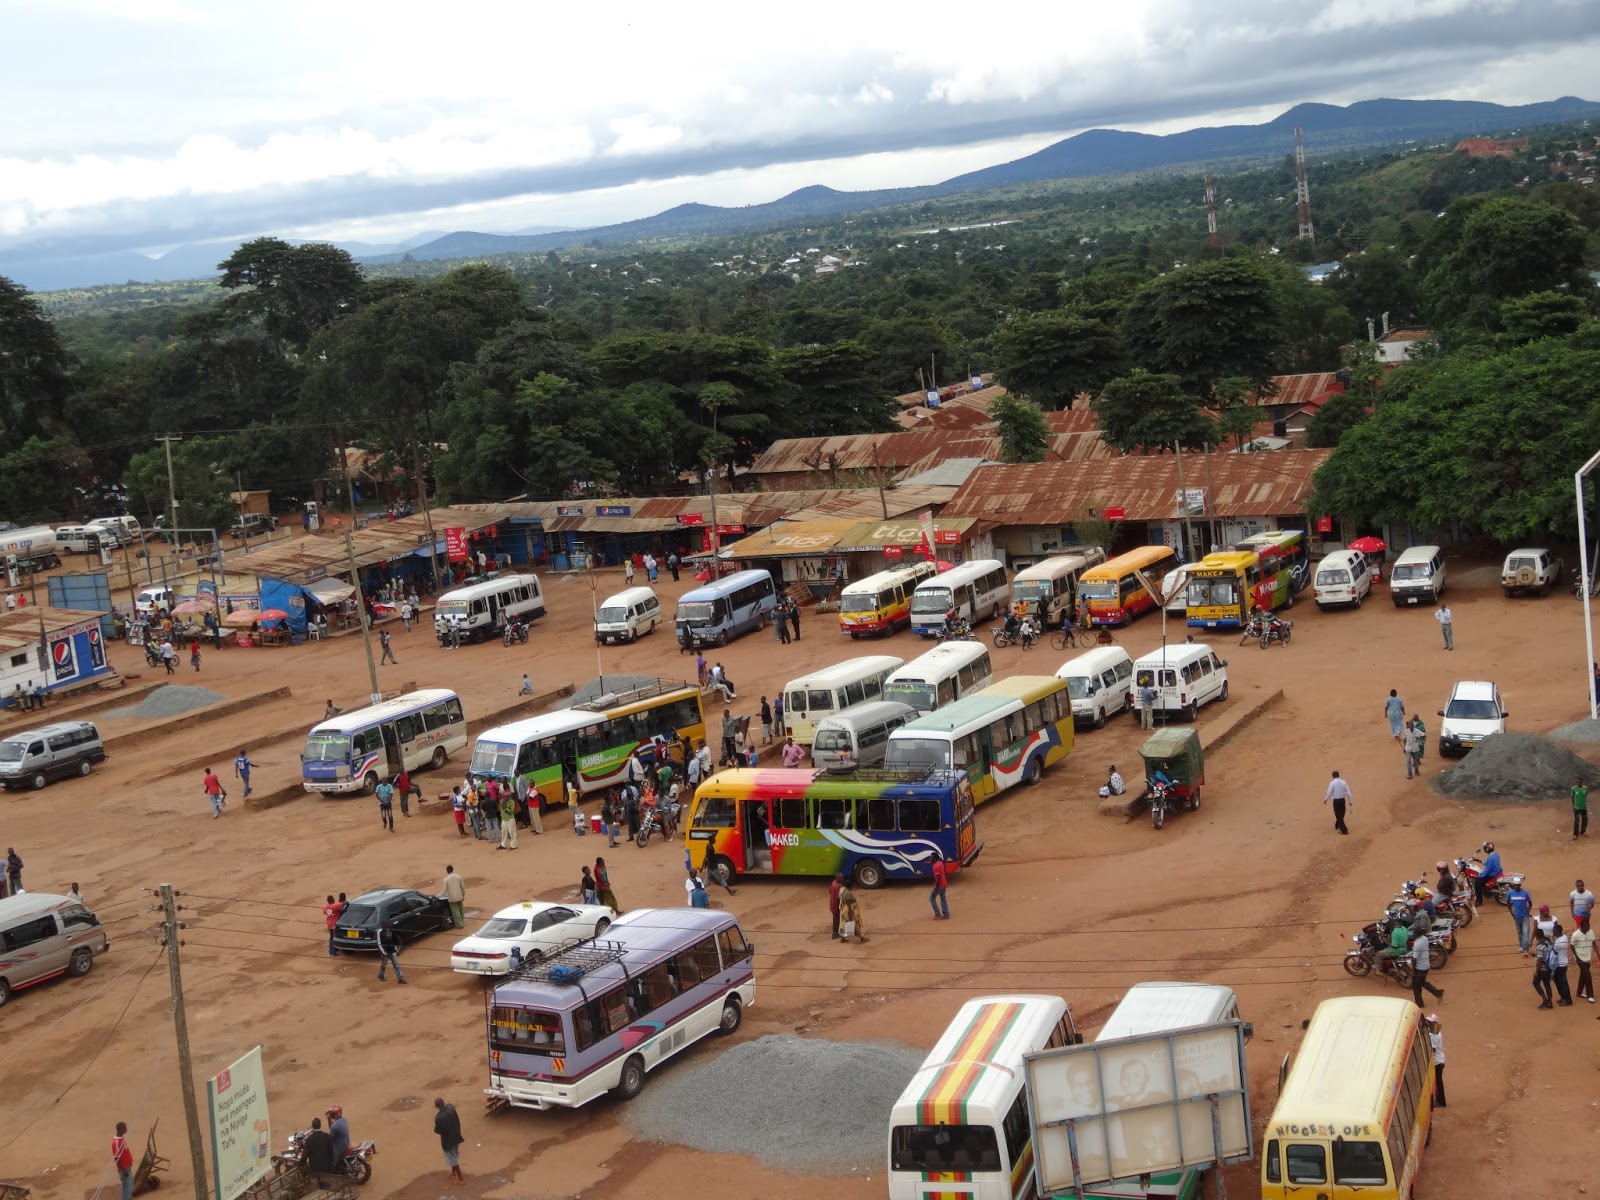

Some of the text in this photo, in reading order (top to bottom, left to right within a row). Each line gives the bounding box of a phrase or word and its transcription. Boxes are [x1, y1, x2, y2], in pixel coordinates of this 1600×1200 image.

[20, 540, 33, 548] LTD
[776, 535, 834, 548] tigo
[56, 664, 74, 677] pepsi
[581, 754, 604, 769] BAMBO
[770, 833, 800, 846] MAKEO
[218, 1096, 234, 1112] Kopa
[233, 1084, 250, 1100] muda
[219, 1092, 257, 1125] wa maongezi
[220, 1113, 249, 1139] na Nipige
[221, 1136, 237, 1151] Tafu
